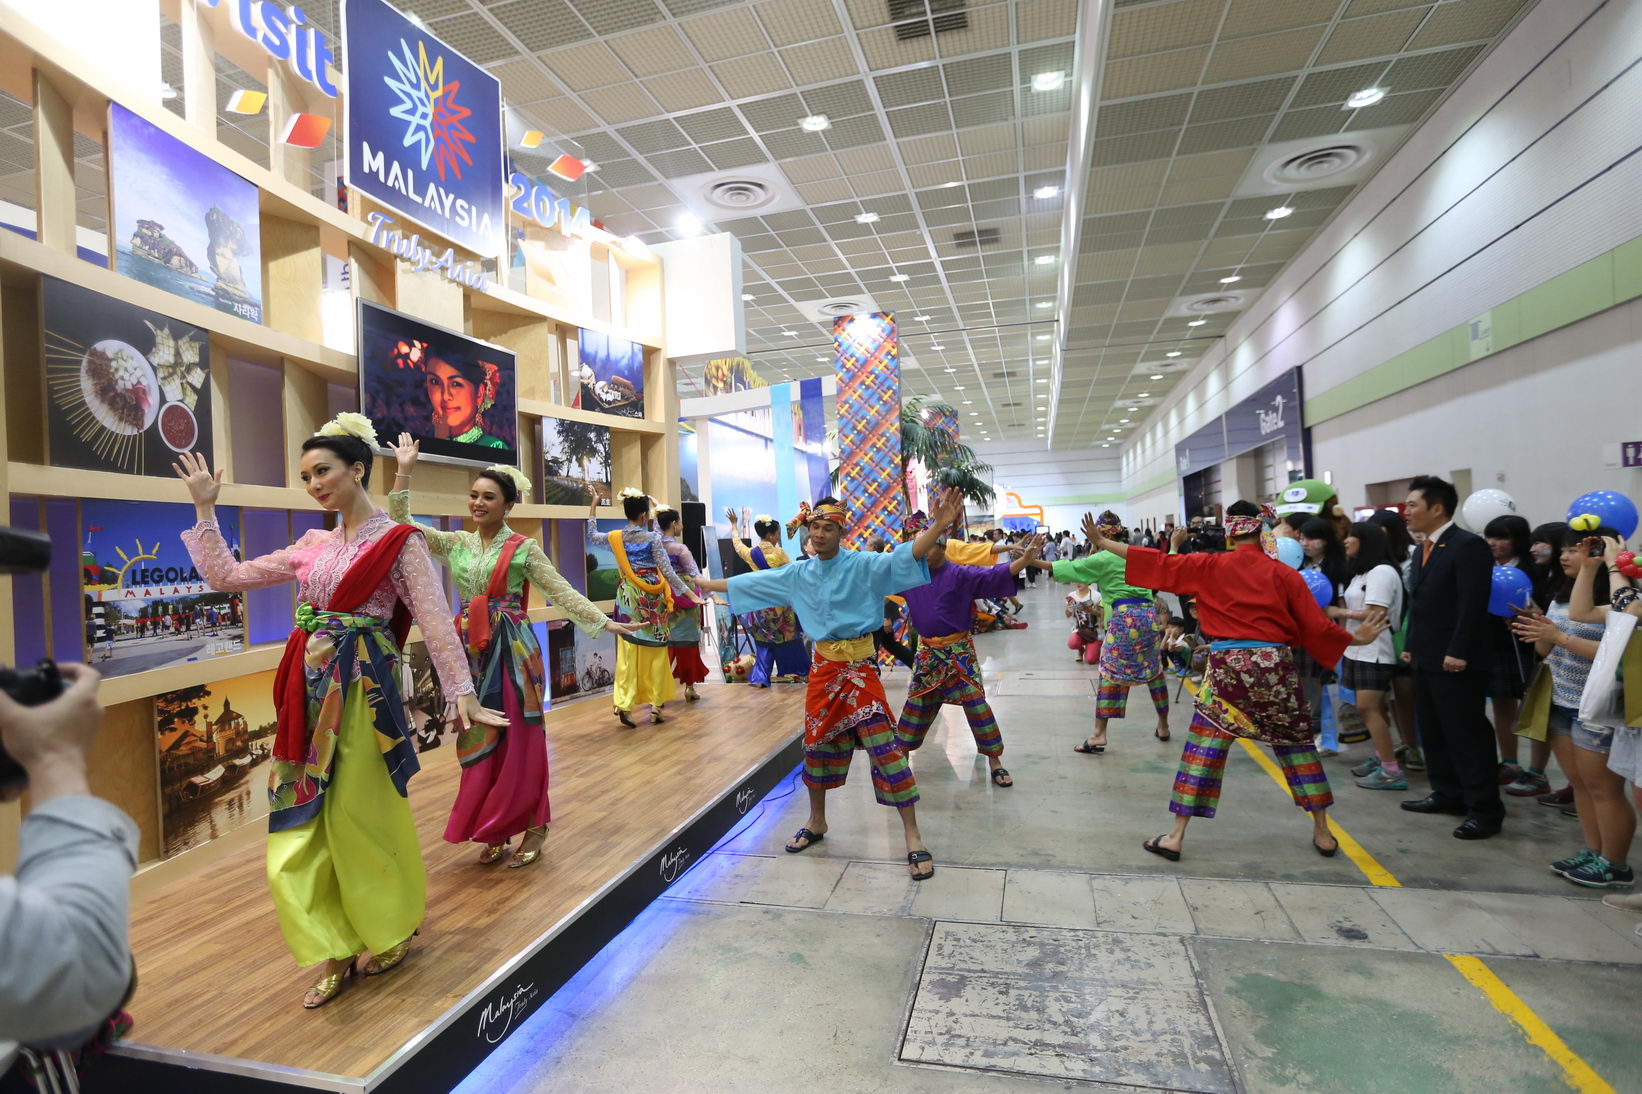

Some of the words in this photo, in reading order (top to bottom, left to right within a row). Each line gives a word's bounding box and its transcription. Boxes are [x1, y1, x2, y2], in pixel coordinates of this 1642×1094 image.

[202, 0, 338, 98] isit
[362, 140, 494, 239] MALAYSIA
[509, 172, 593, 239] 2014
[367, 211, 432, 273] Truly
[430, 247, 489, 291] Asia
[124, 584, 205, 598] MALAYS
[131, 567, 203, 585] LEGOLA
[477, 982, 534, 1043] Malaysia
